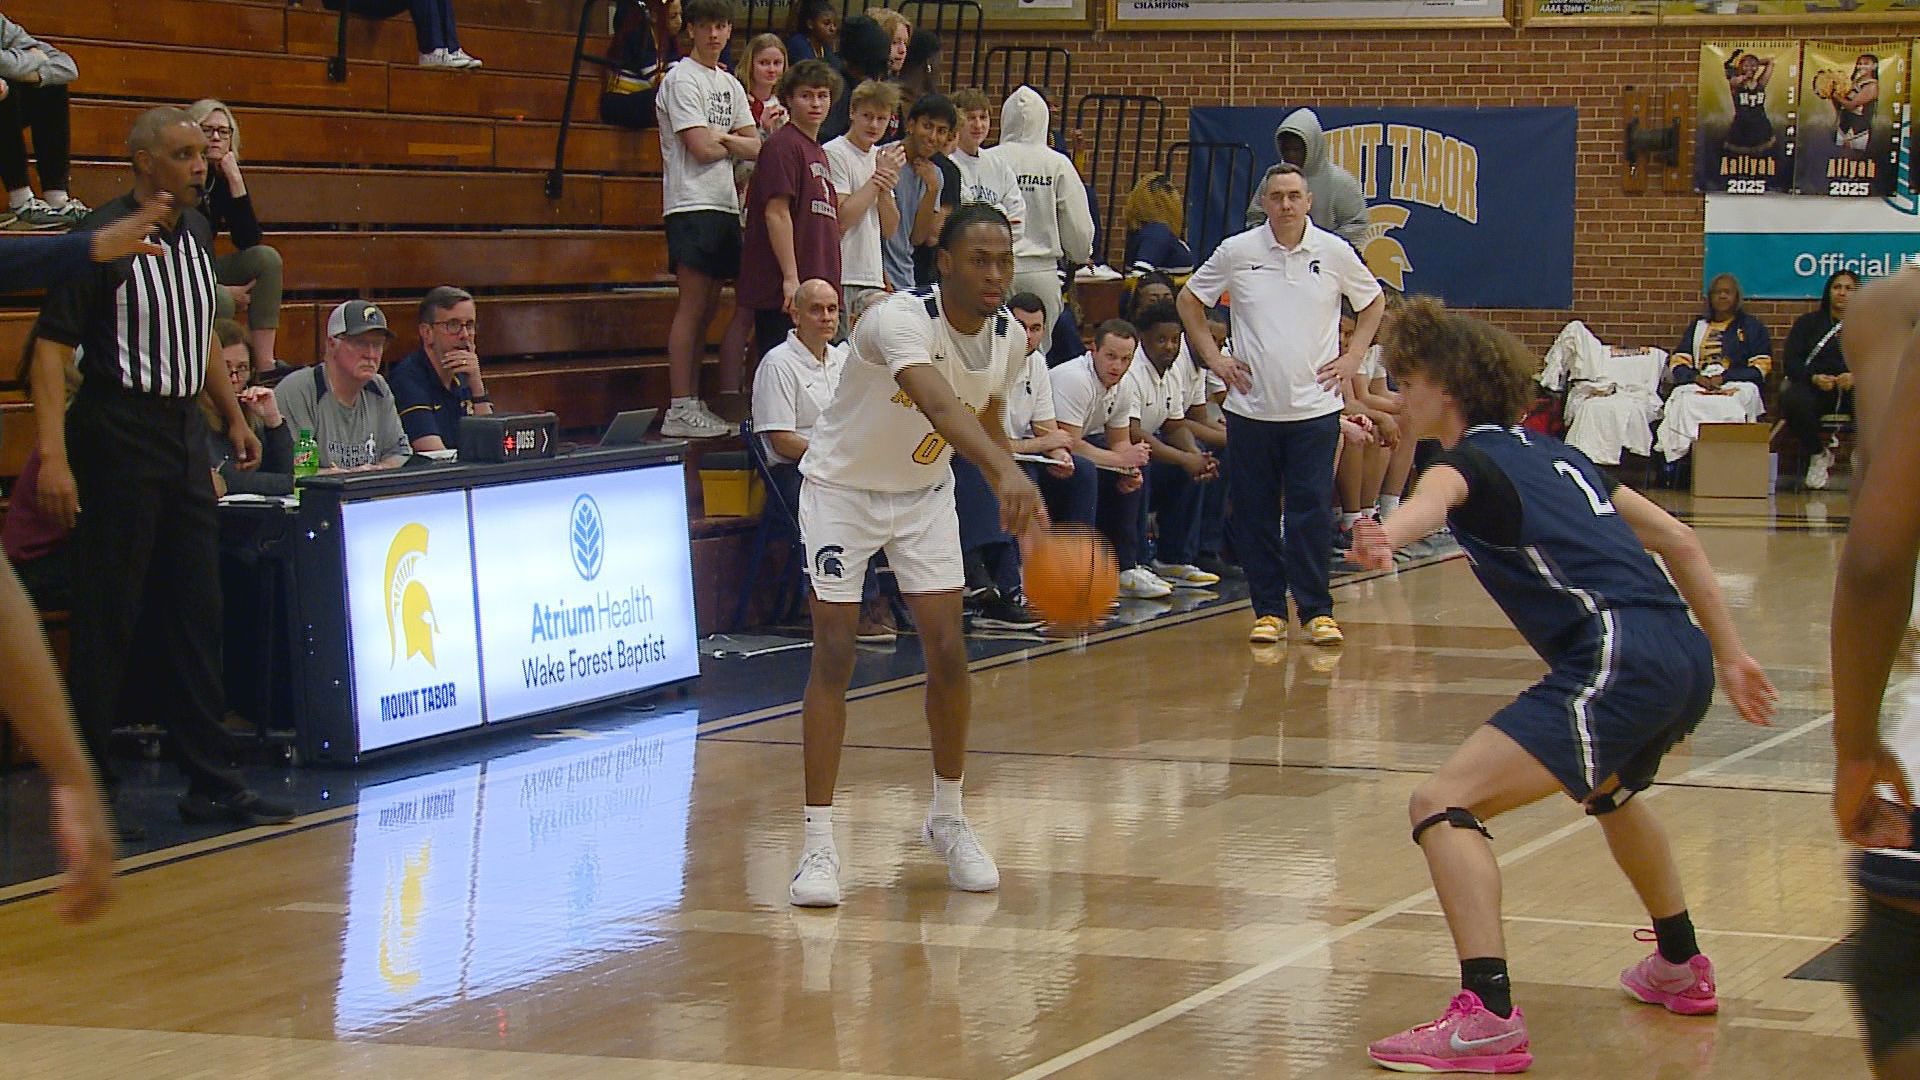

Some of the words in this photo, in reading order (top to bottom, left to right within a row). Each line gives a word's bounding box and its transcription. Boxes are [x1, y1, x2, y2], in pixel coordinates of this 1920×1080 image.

[1134, 1, 1190, 9] CHAMPIONS
[1387, 123, 1478, 225] TABOR
[1720, 155, 1776, 176] Aaliyah
[1727, 180, 1767, 195] 2025
[1829, 182, 1870, 196] 2025
[1794, 252, 1890, 277] Official
[912, 432, 947, 465] 0
[531, 599, 595, 644] Atrium
[597, 584, 654, 631] Health
[522, 653, 566, 689] Wake
[569, 644, 614, 680] Forest
[617, 633, 666, 673] Baptist
[380, 689, 419, 722] MOUNT
[421, 681, 457, 713] TABOR
